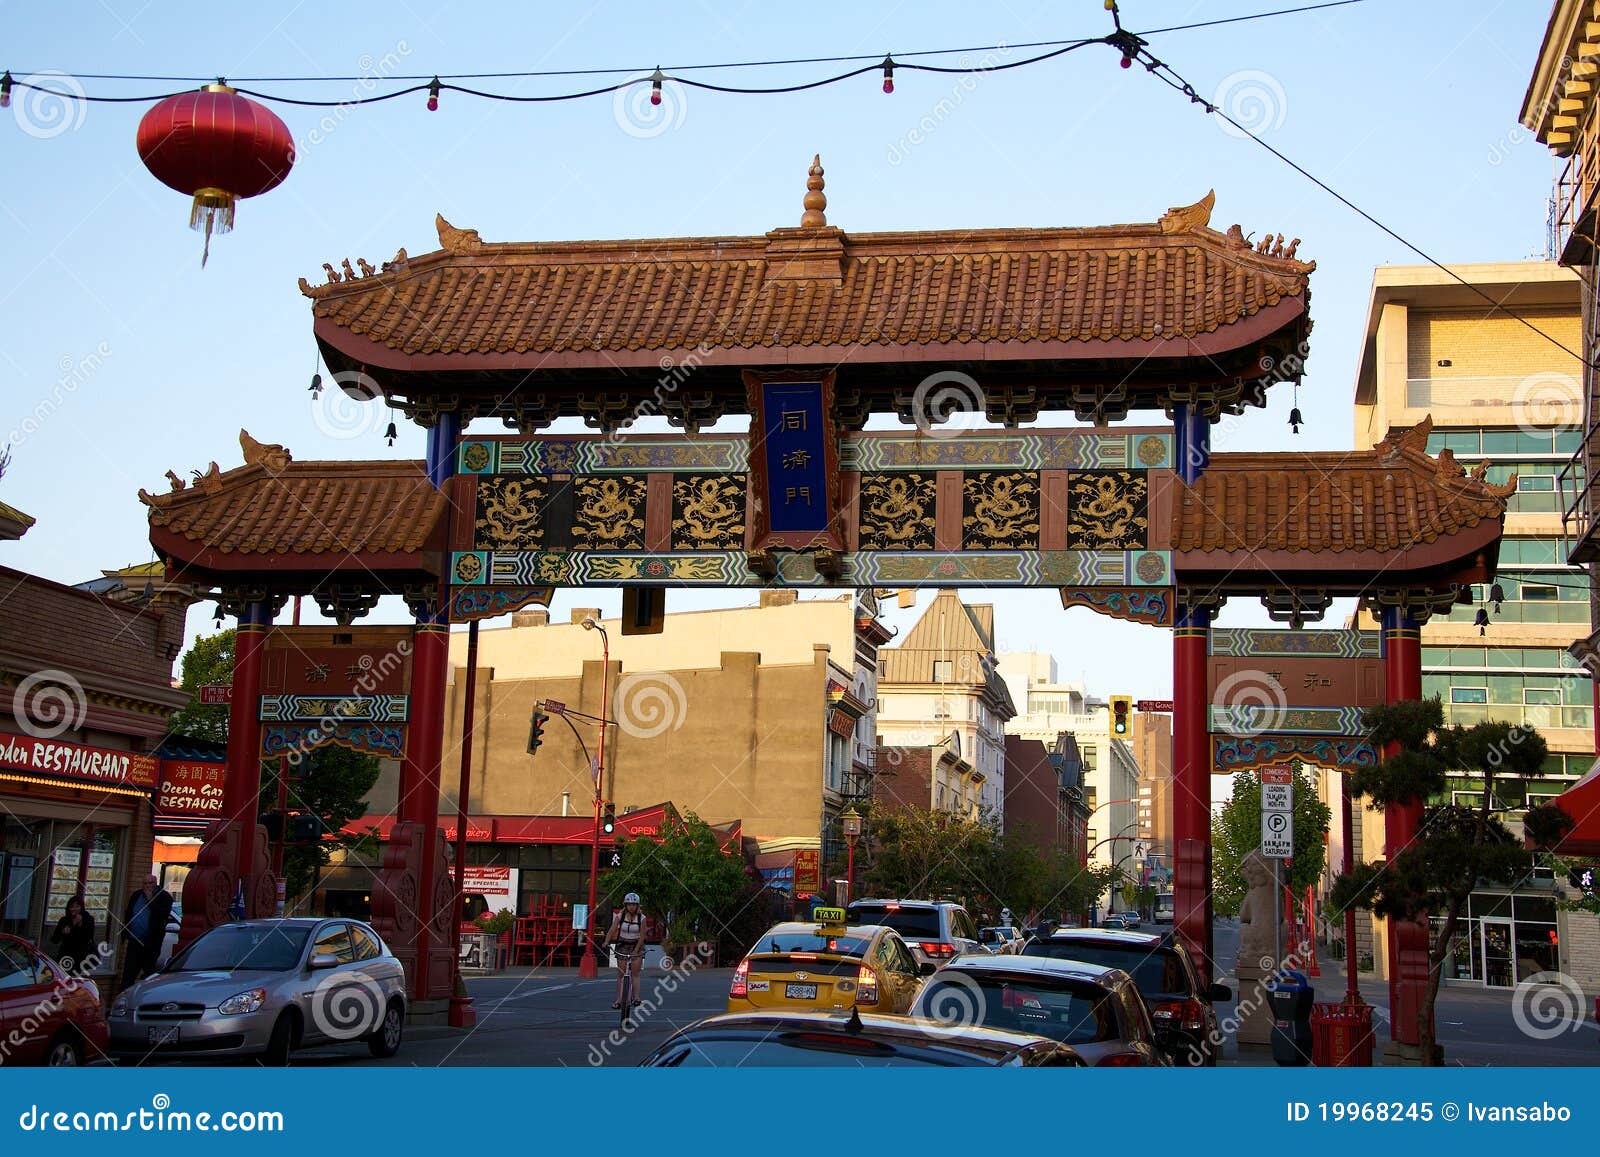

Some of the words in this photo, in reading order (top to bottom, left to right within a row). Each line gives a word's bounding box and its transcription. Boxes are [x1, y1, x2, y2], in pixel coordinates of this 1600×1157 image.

[31, 742, 130, 780] RESTAURANT
[161, 781, 196, 795] Ocean
[630, 826, 656, 836] OPEN
[818, 910, 840, 920] TAXI
